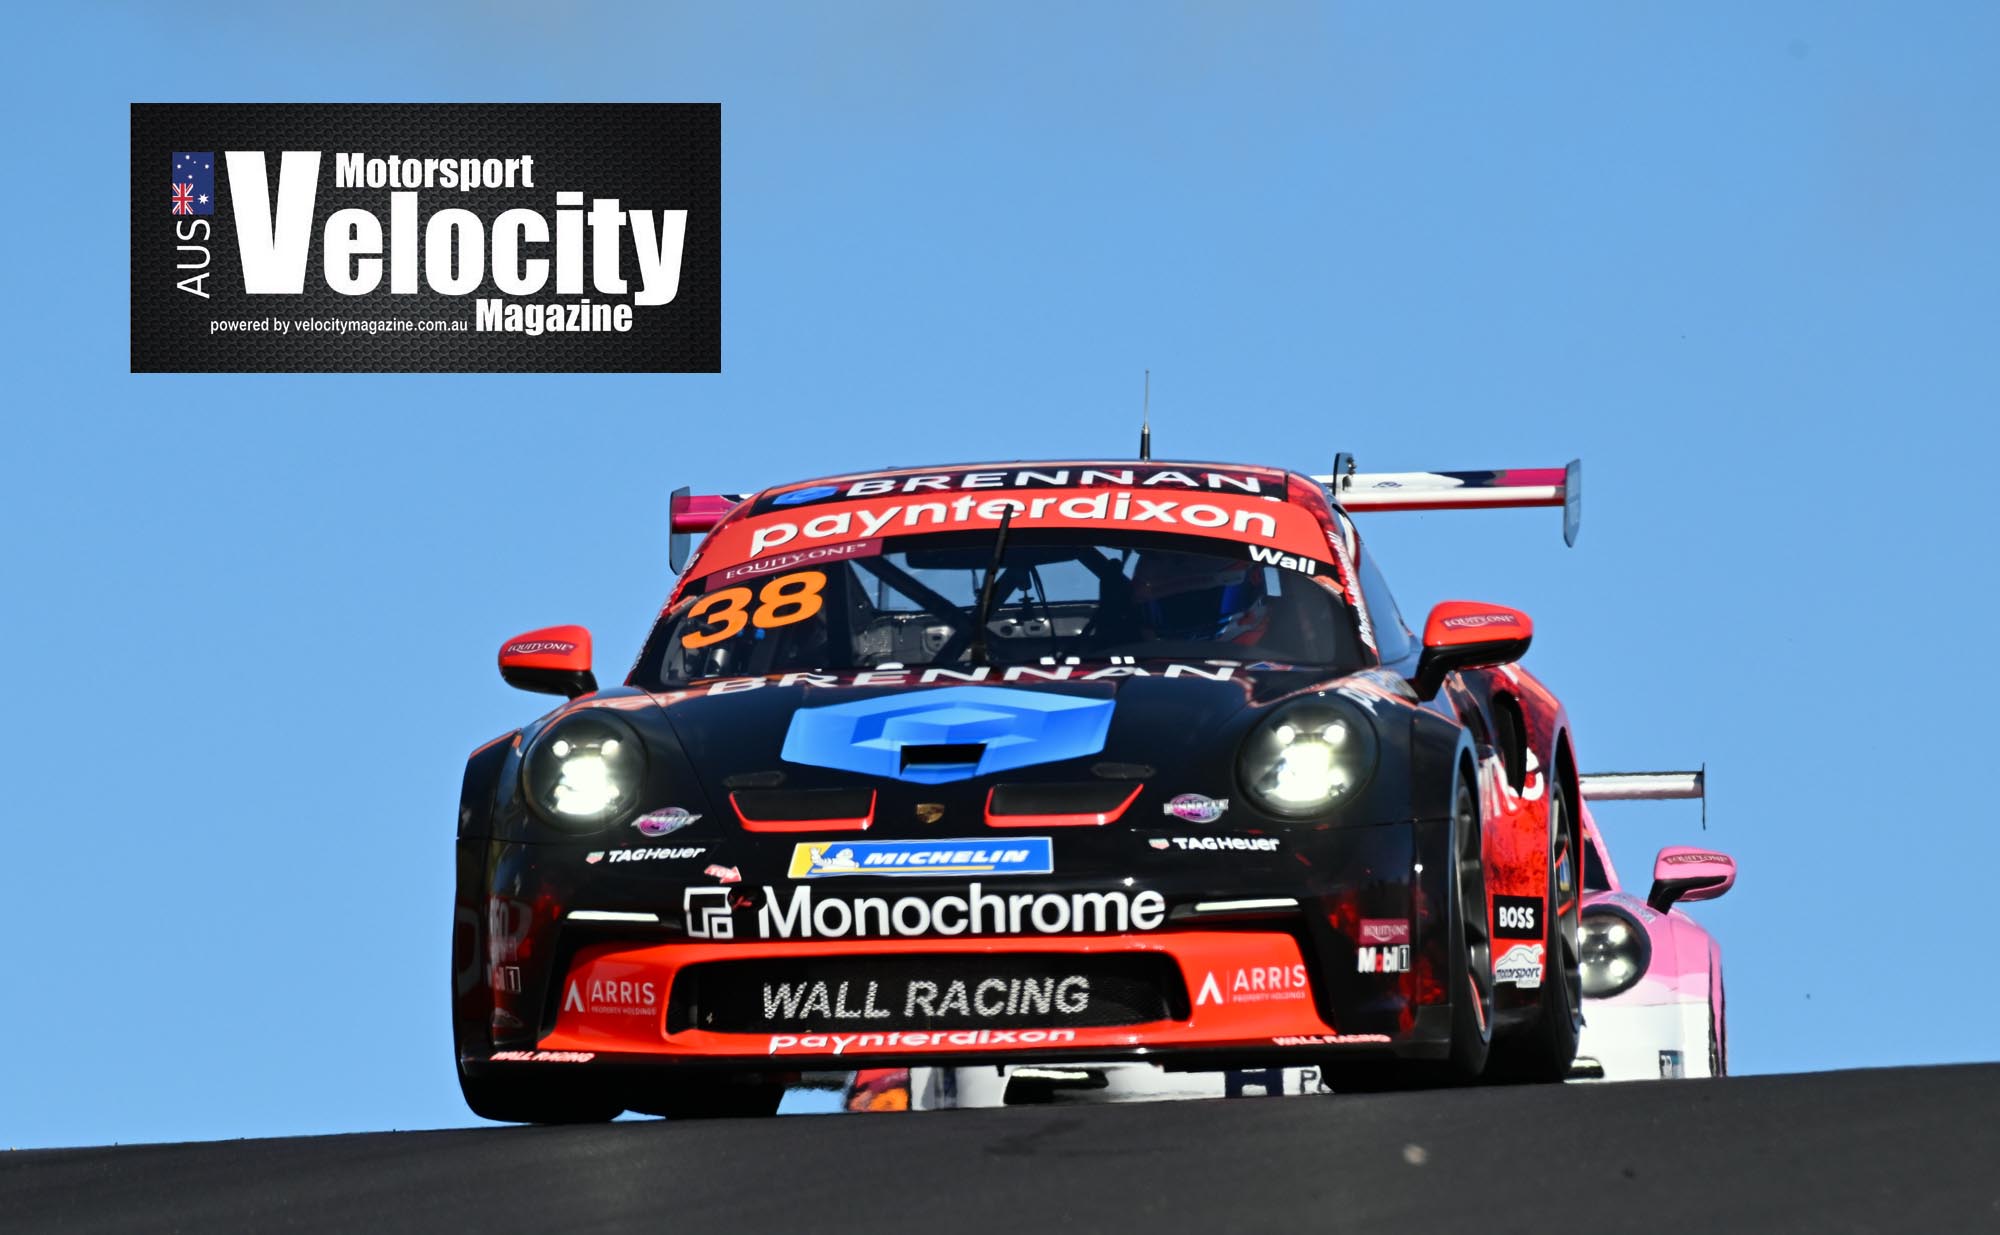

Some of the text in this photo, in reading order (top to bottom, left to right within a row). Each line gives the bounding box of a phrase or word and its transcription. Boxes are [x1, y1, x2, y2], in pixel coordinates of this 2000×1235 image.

[845, 470, 1261, 497] BRENNAN
[749, 492, 1277, 558] paynterdixon
[1248, 544, 1316, 576] Wall
[681, 570, 827, 649] 38
[706, 663, 1235, 697] BRENNAN
[864, 849, 1030, 866] MICHELIN
[758, 882, 1166, 939] Monochrome
[1498, 906, 1535, 929] BOSS
[1233, 964, 1306, 992] ARRIS
[1496, 967, 1541, 979] motorsport
[591, 980, 655, 1006] ARRIS
[763, 975, 1091, 1020] WALL RACING
[768, 1029, 1075, 1055] paynterdixon
[1271, 1035, 1324, 1046] WALL
